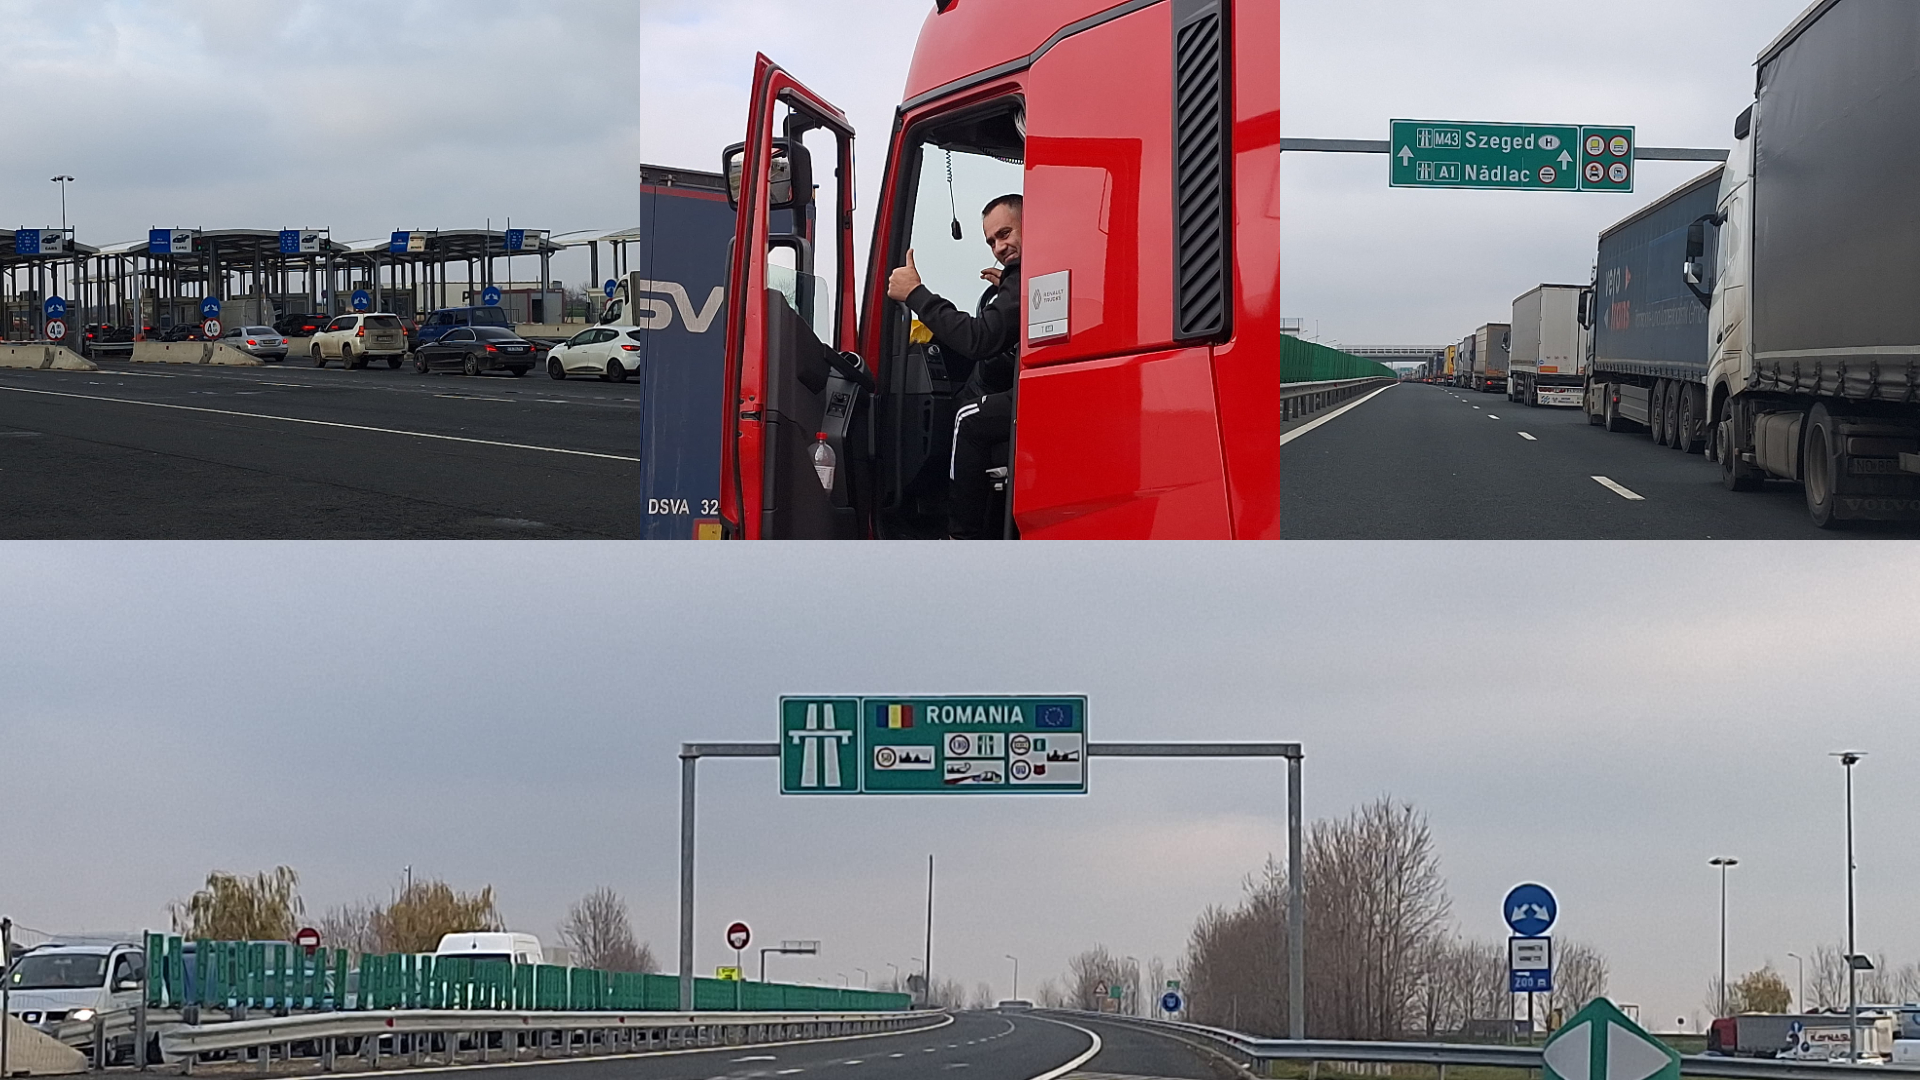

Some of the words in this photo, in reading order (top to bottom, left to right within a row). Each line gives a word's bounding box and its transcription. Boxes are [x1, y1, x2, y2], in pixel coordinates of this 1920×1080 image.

[1435, 132, 1459, 146] M43
[1466, 132, 1534, 153] Szeged
[1545, 137, 1553, 147] H
[1439, 165, 1455, 178] A1
[1465, 165, 1530, 182] Nădlac
[50, 324, 56, 335] 4
[648, 498, 690, 515] DSVA
[926, 705, 1024, 724] ROMANIA
[881, 752, 892, 763] 50
